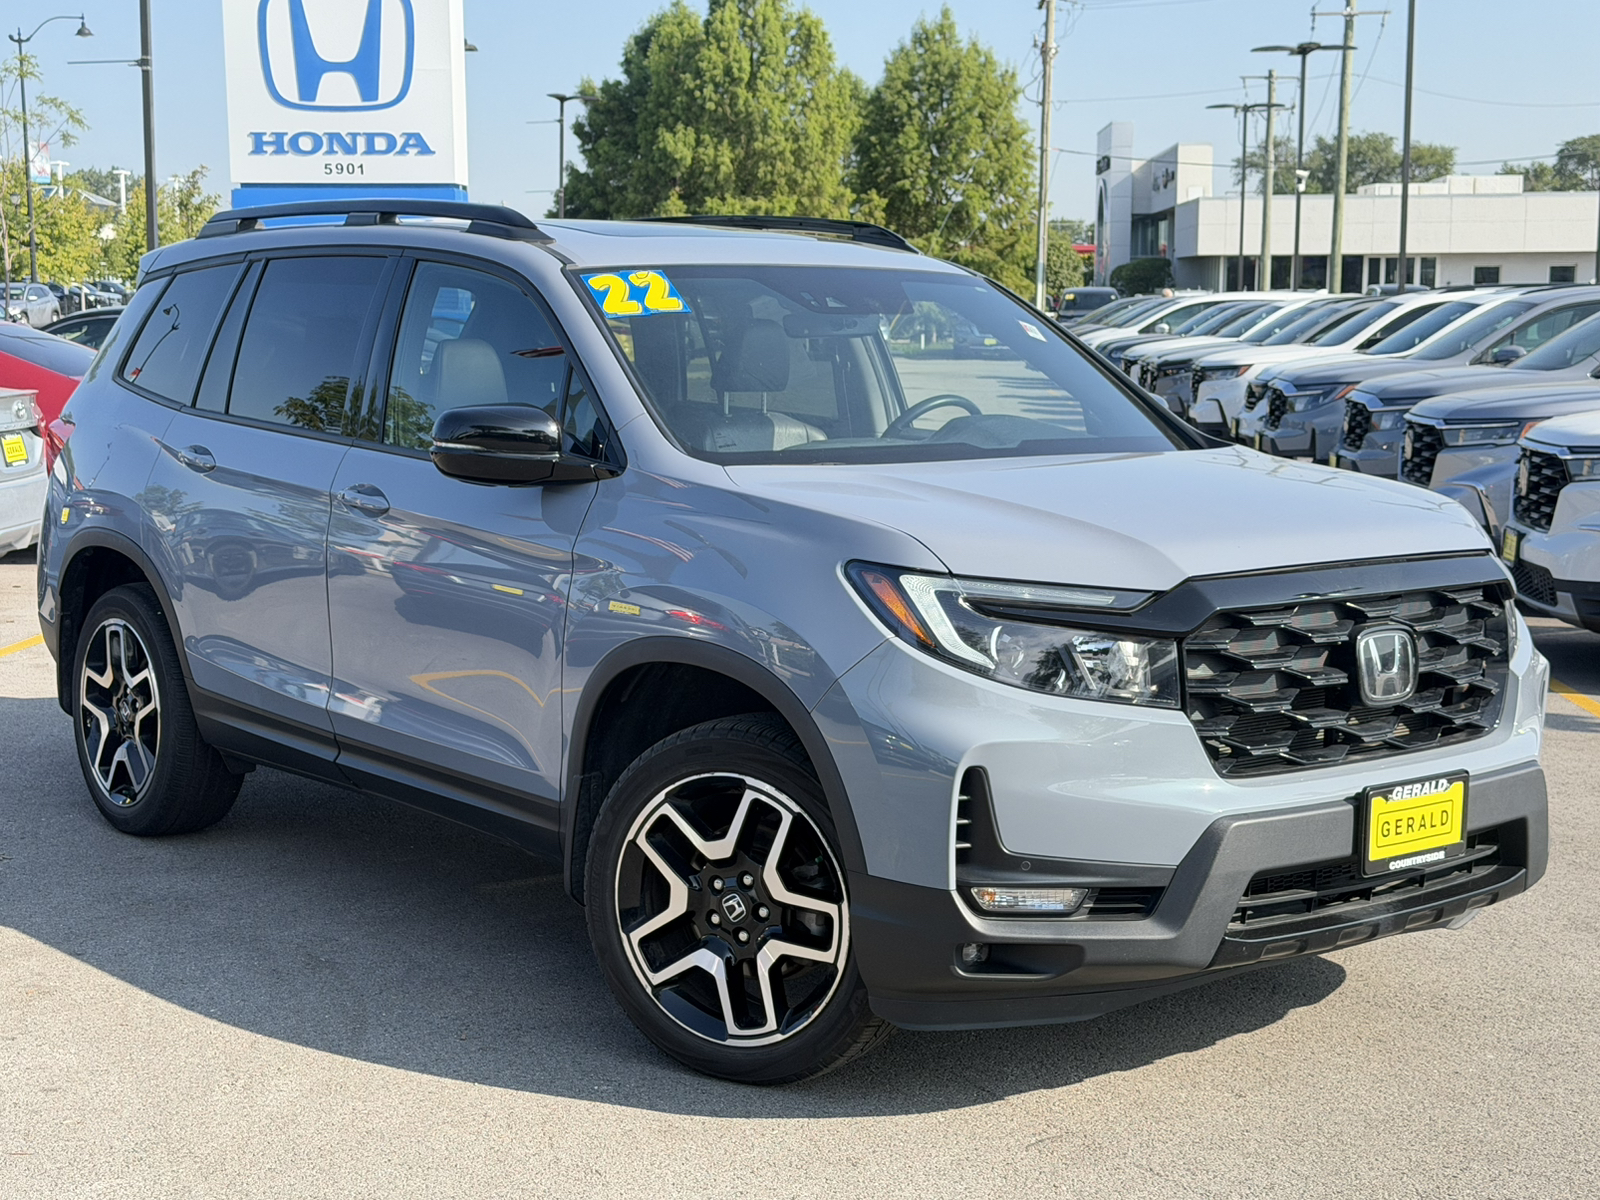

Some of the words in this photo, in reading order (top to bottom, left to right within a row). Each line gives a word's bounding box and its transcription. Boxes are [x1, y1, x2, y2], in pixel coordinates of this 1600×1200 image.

[248, 132, 436, 156] HONDA
[324, 163, 365, 175] 5901
[588, 271, 683, 314] 22
[1392, 779, 1448, 800] GERALD
[1381, 810, 1449, 838] GERALD
[1389, 851, 1446, 871] COUNTRYSIDE
